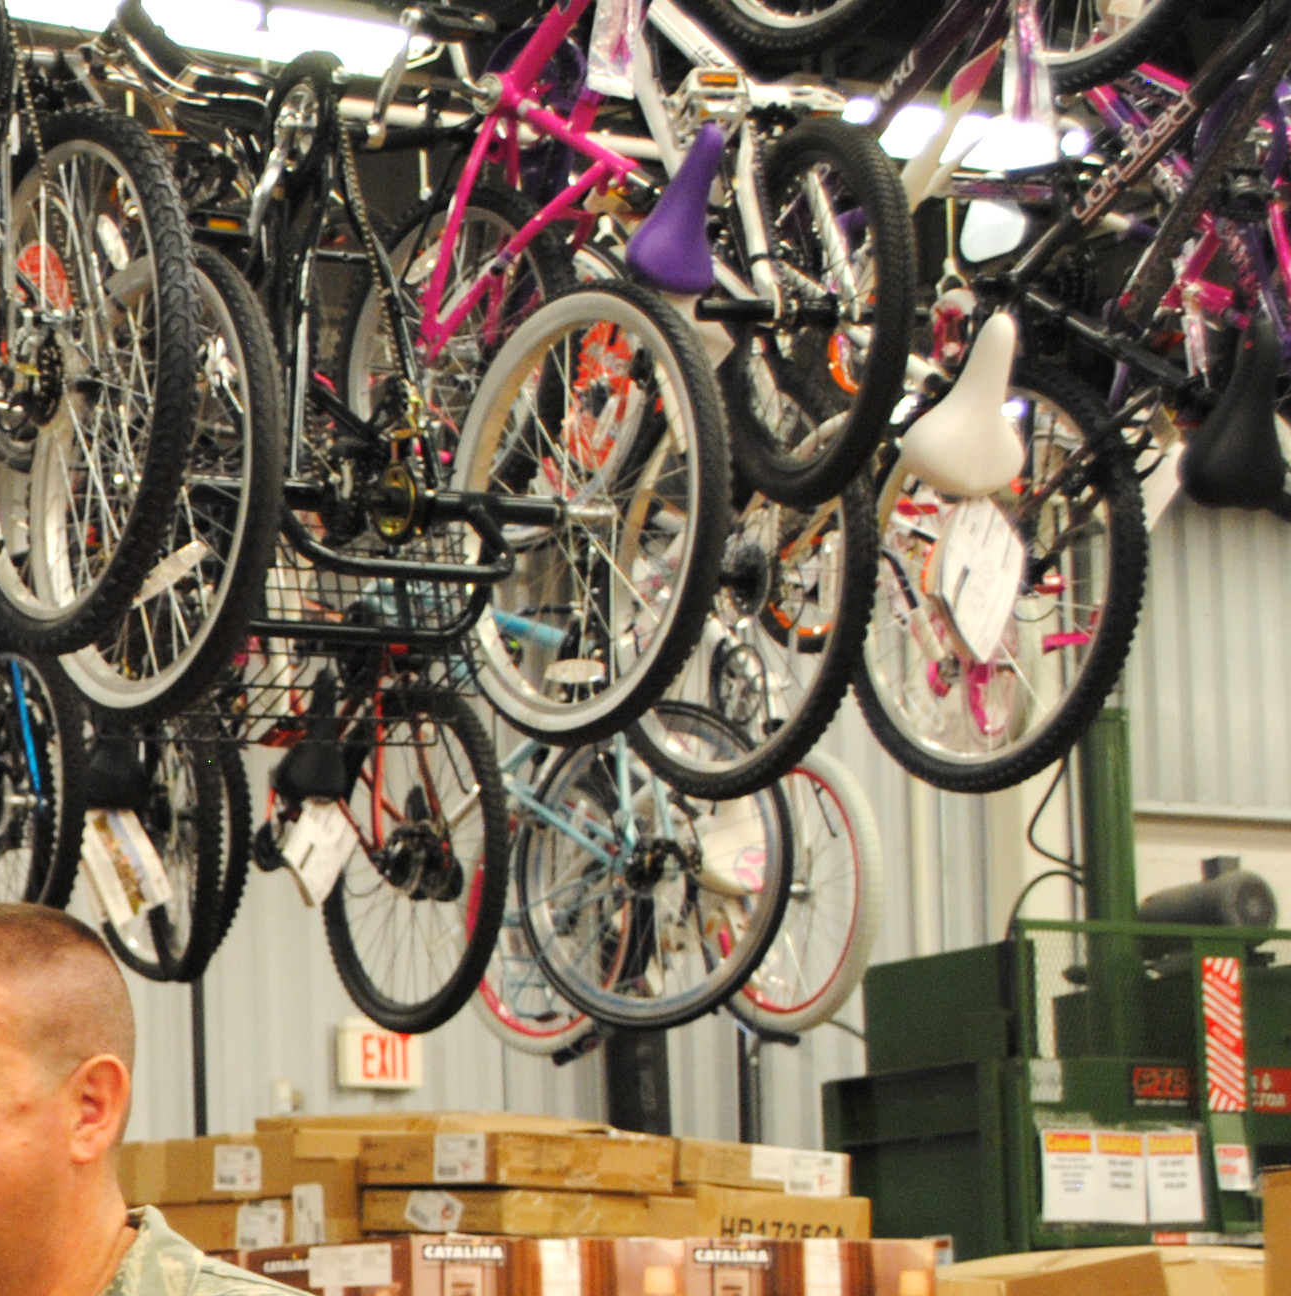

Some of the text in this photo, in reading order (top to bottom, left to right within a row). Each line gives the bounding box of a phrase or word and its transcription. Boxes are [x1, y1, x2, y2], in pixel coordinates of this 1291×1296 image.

[1072, 93, 1197, 220] Reaction
[362, 1033, 411, 1080] EXIT
[423, 1244, 504, 1260] CATALINA
[694, 1247, 770, 1263] CATALINA
